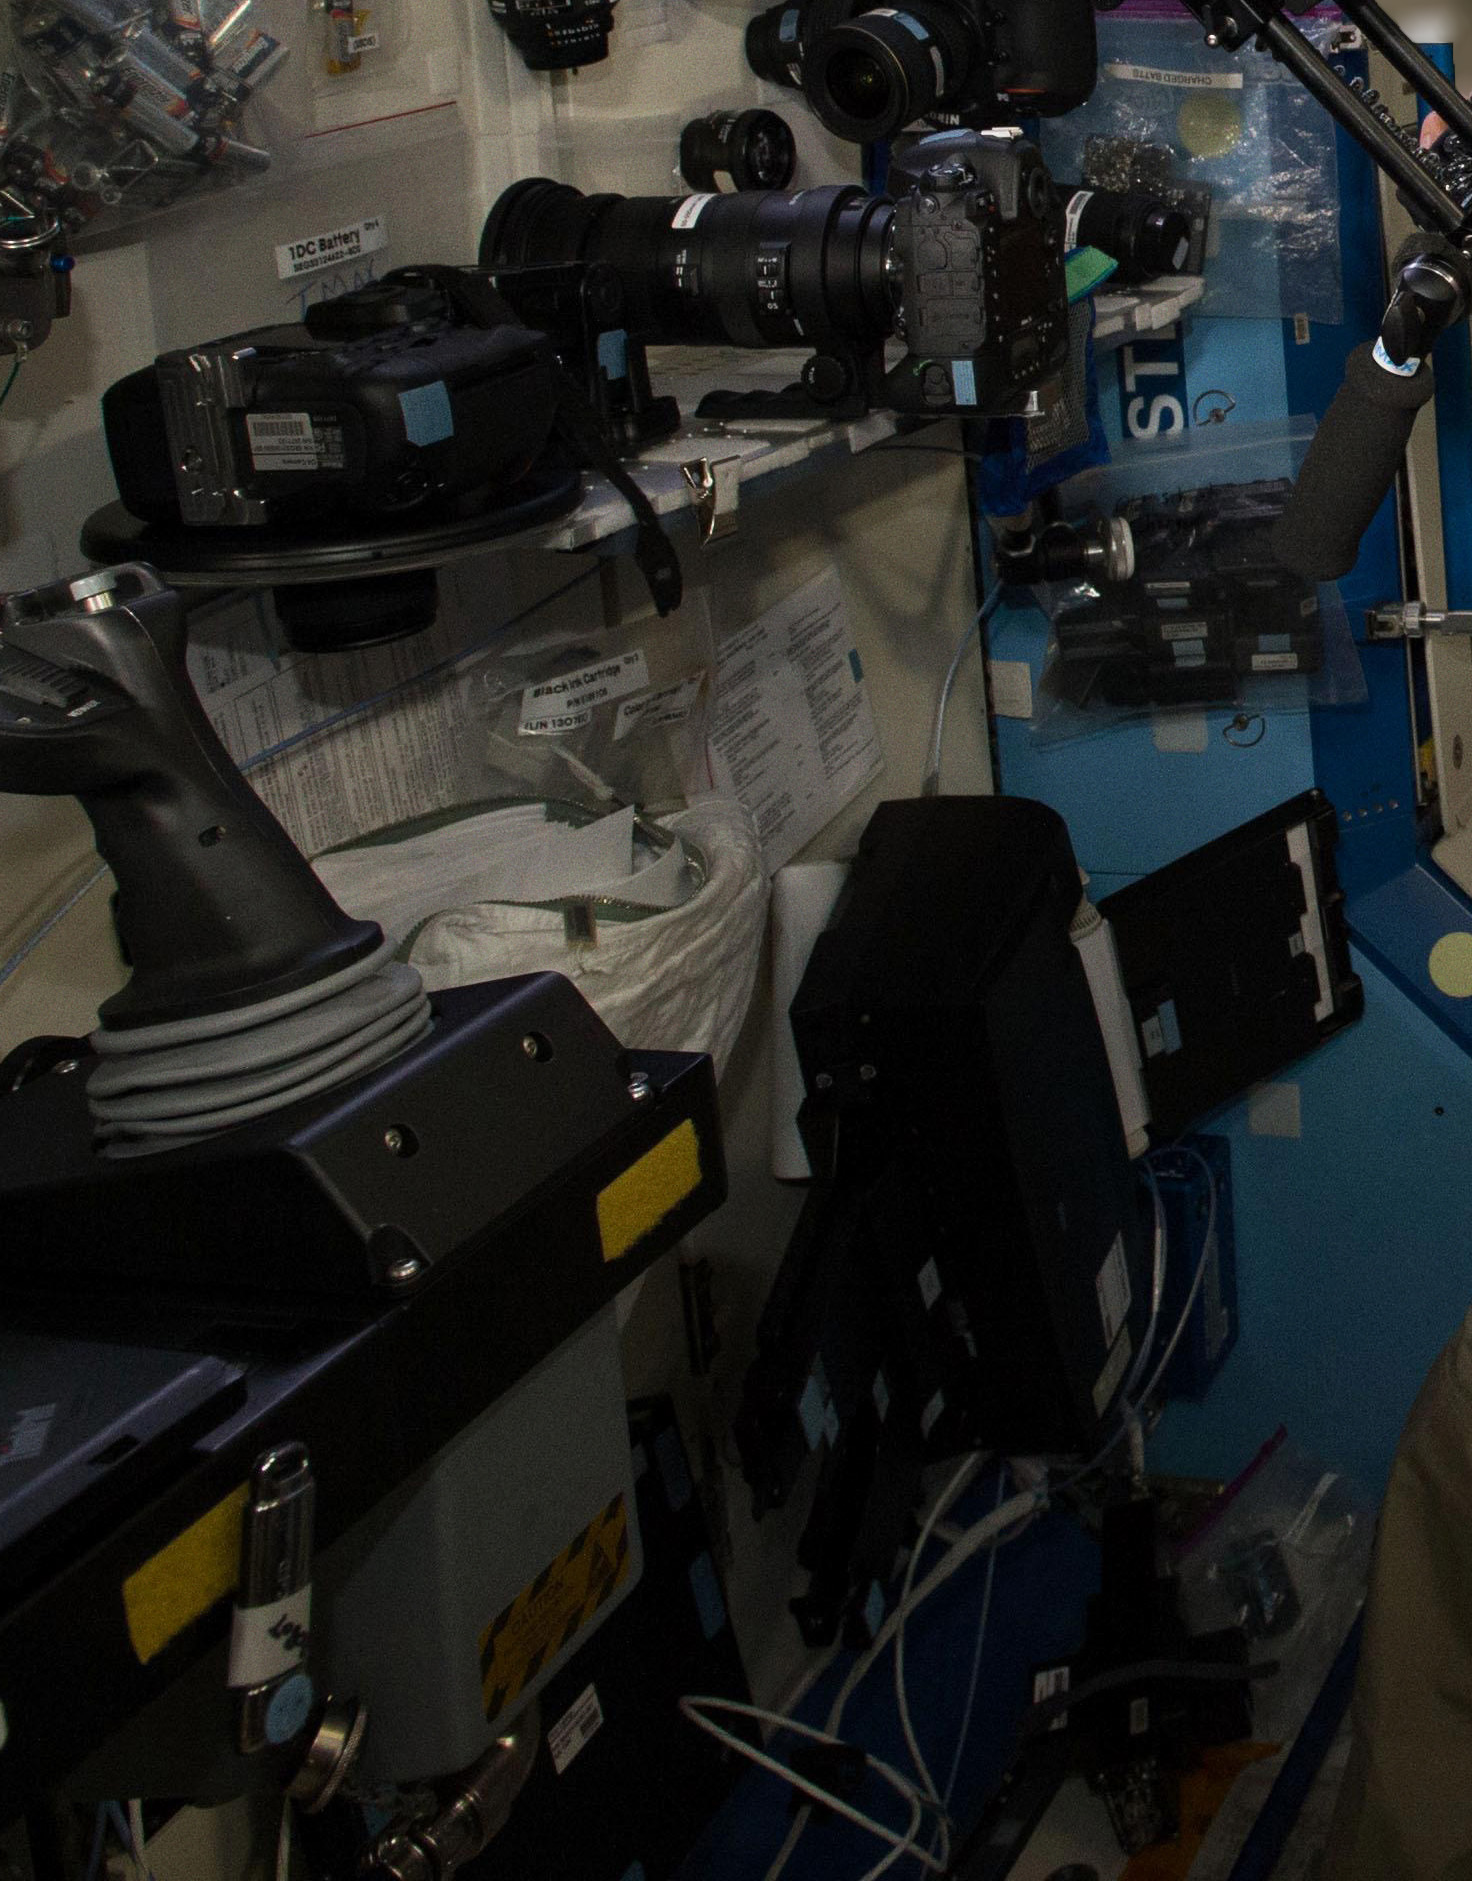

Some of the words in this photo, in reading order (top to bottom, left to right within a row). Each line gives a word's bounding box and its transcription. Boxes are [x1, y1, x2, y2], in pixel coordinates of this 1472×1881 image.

[1163, 73, 1212, 86] CHARGED
[318, 228, 361, 252] Battery
[582, 664, 621, 684] Cartridge
